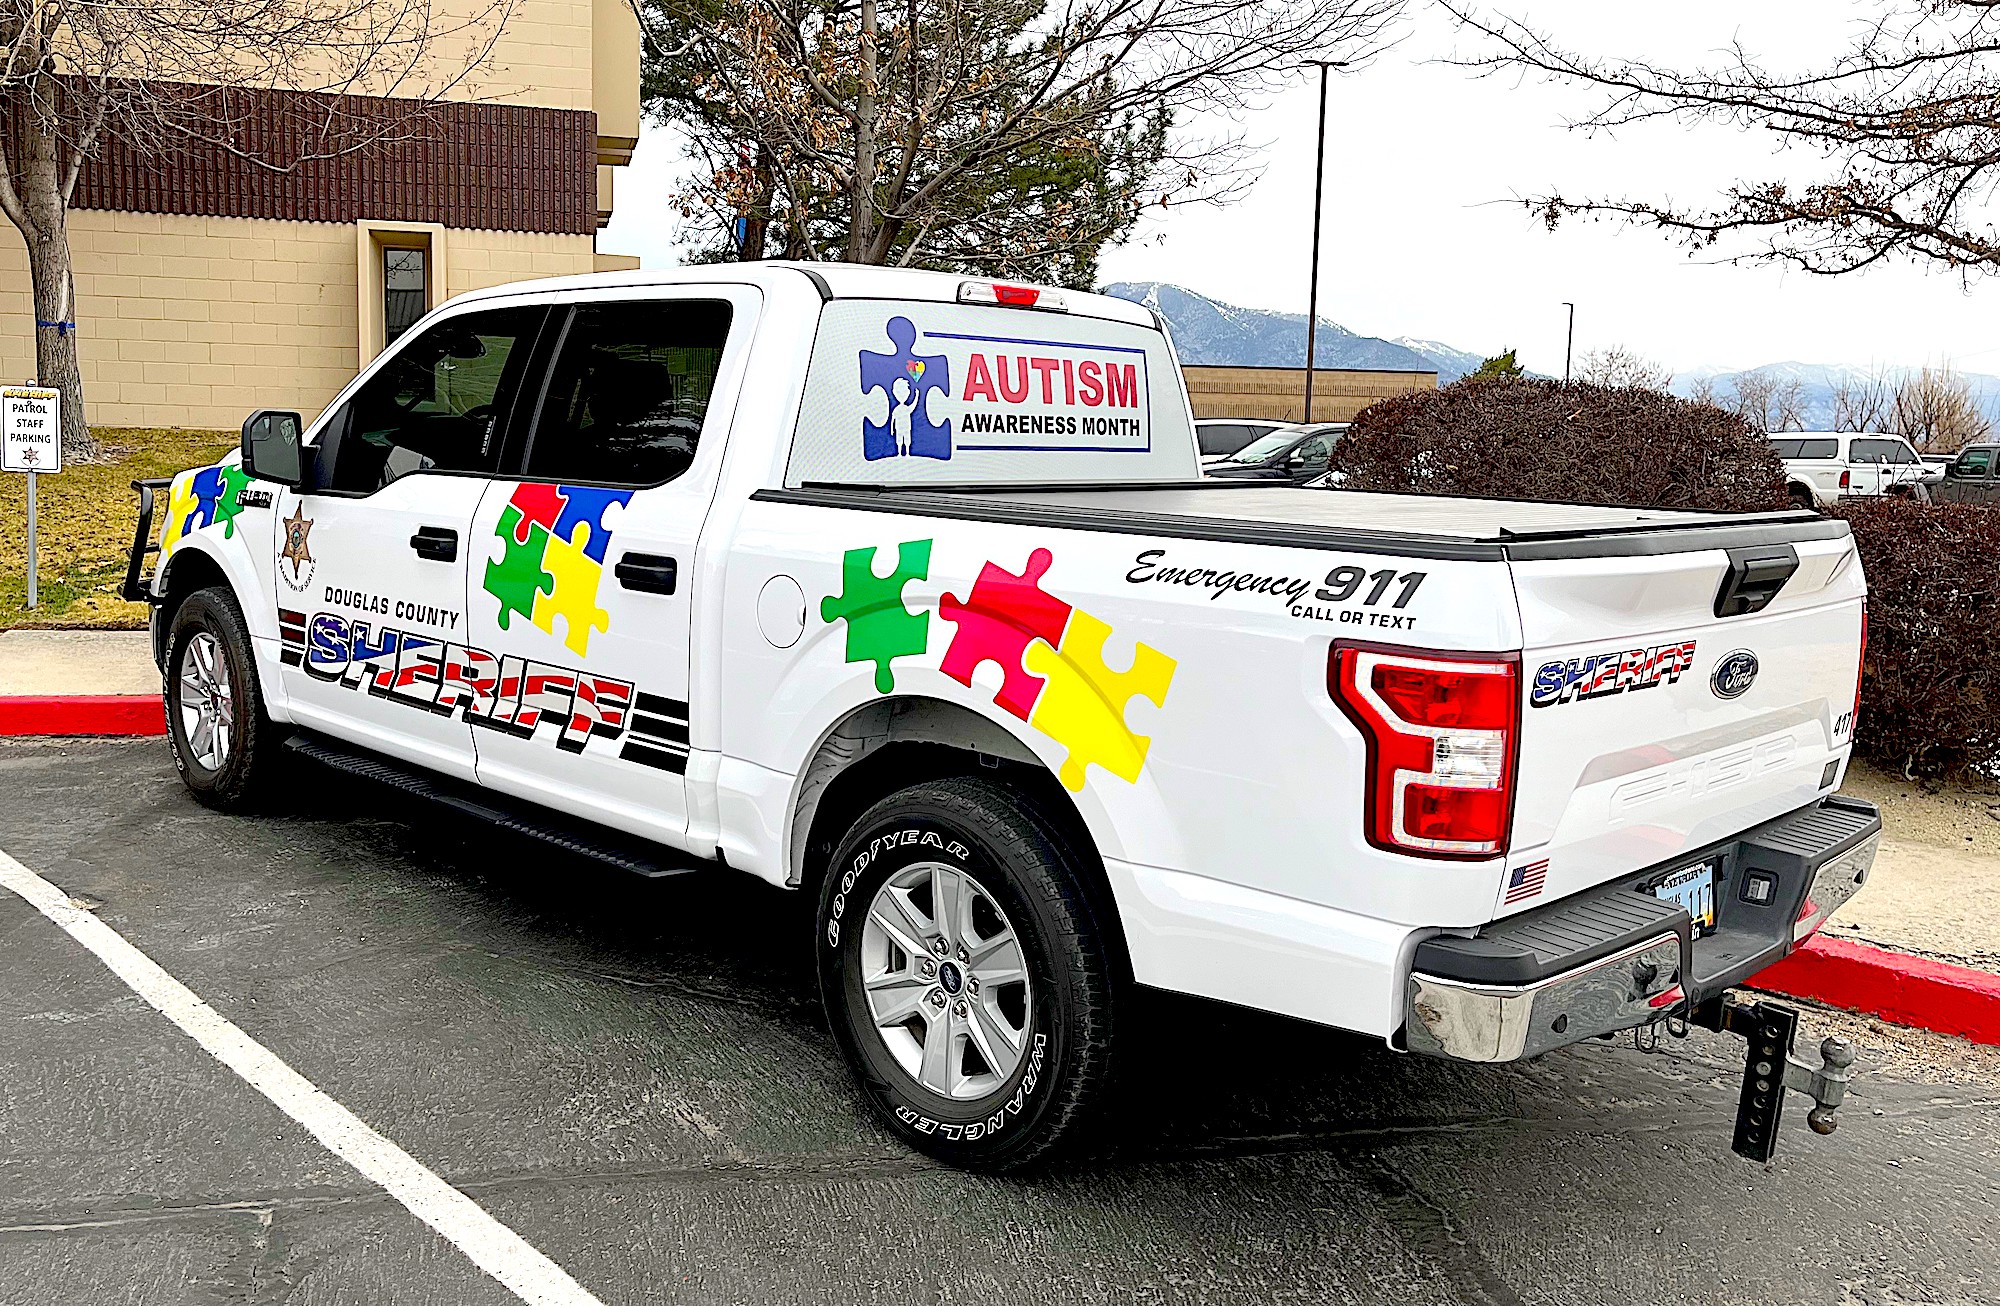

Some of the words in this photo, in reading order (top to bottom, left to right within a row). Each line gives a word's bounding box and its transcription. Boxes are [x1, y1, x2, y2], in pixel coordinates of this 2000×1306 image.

[962, 353, 1138, 409] AUTISM
[12, 403, 48, 414] PATROL
[16, 418, 44, 428] STAFF
[961, 413, 1077, 435] AWARENESS
[1082, 417, 1141, 437] MONTH
[10, 433, 51, 444] PARKING
[1125, 549, 1312, 607] Emergency
[1315, 565, 1428, 609] 911
[324, 585, 390, 615] DOUGLAS
[395, 600, 460, 630] COUNTY
[1291, 605, 1335, 622] CALL
[1339, 610, 1364, 625] OR
[1369, 613, 1417, 631] TEXT
[303, 612, 636, 756] SHERIFF
[1530, 640, 1697, 709] SHERIFF
[1724, 659, 1754, 692] Ford
[1833, 711, 1852, 737] 417
[828, 829, 971, 948] GOODYEAR
[895, 1033, 1047, 1141] WRANGLER
